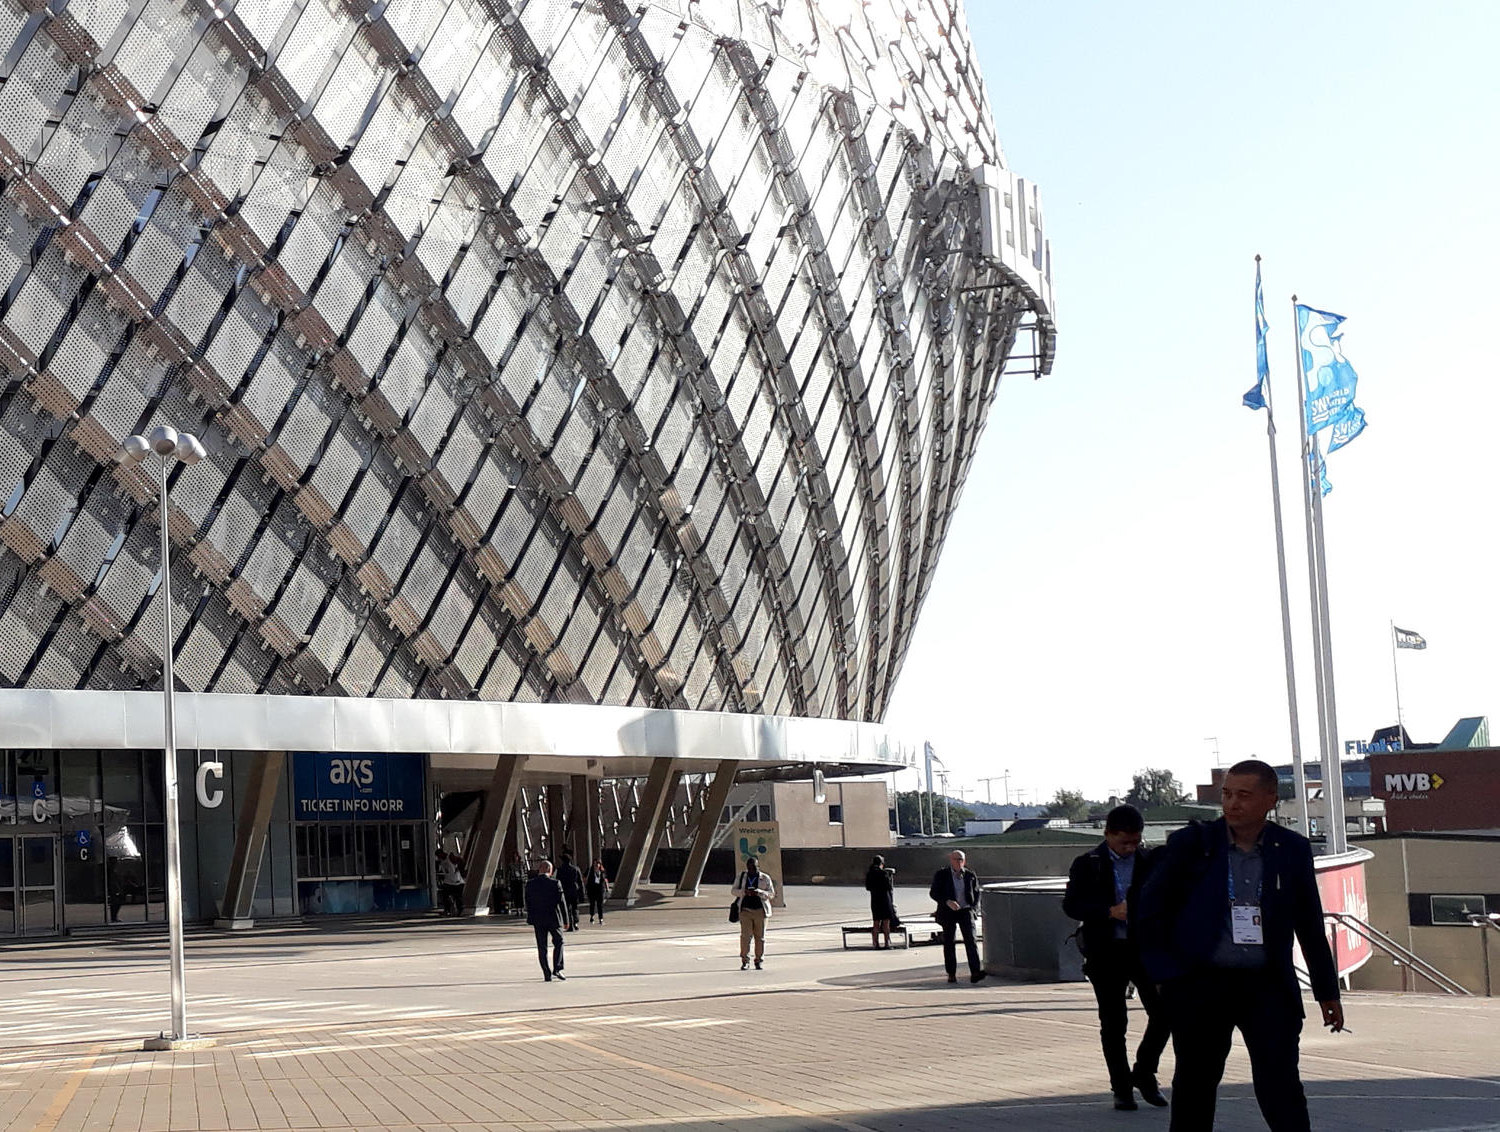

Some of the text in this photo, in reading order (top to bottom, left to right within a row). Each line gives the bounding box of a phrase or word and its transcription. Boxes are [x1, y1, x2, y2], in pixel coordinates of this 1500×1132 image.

[195, 761, 224, 808] C
[1384, 773, 1431, 792] MVB
[32, 798, 47, 823] C
[301, 799, 404, 812] TICKET INFO NORR
[80, 848, 88, 861] C
